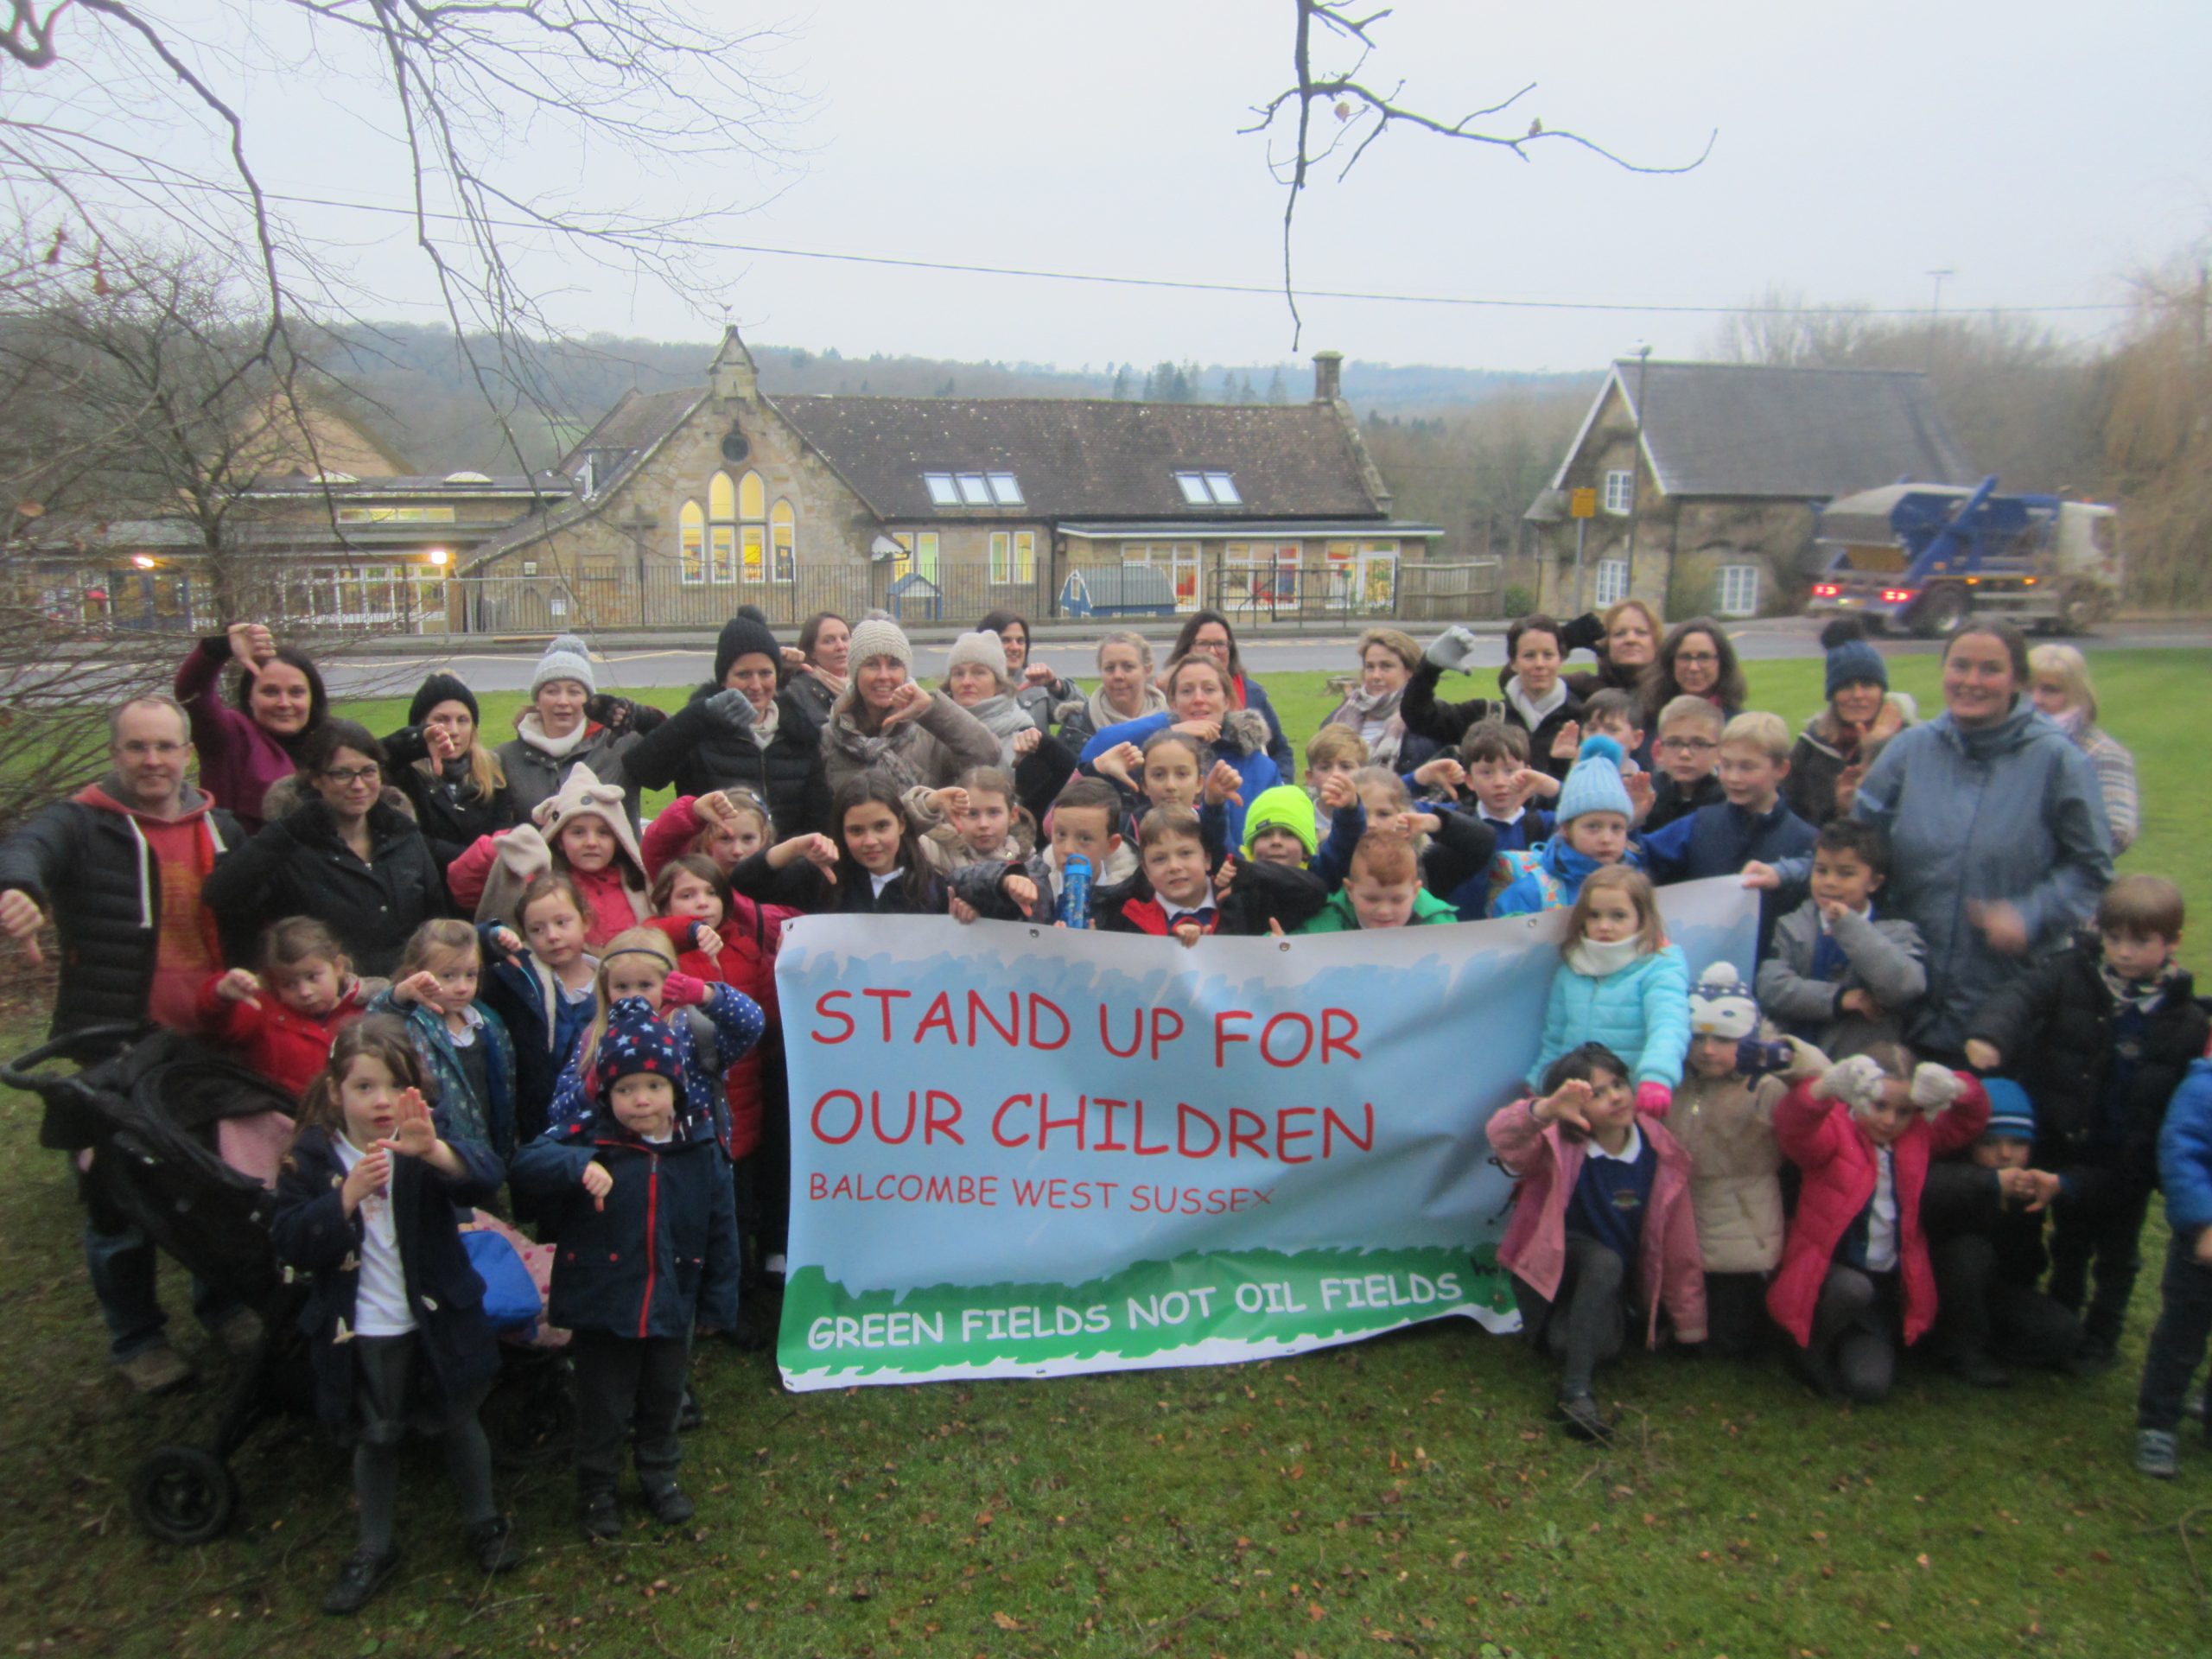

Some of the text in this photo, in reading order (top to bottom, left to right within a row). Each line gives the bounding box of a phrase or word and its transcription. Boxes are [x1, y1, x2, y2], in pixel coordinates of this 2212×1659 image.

[810, 988, 1363, 1069] STAND UP FOR
[810, 1088, 1375, 1165] OUR CHILDREN
[809, 1172, 1275, 1216] BALCOMBE WEST SUSSEX
[807, 1273, 1463, 1351] GREEN FIELDS NOT OIL FIELDS
